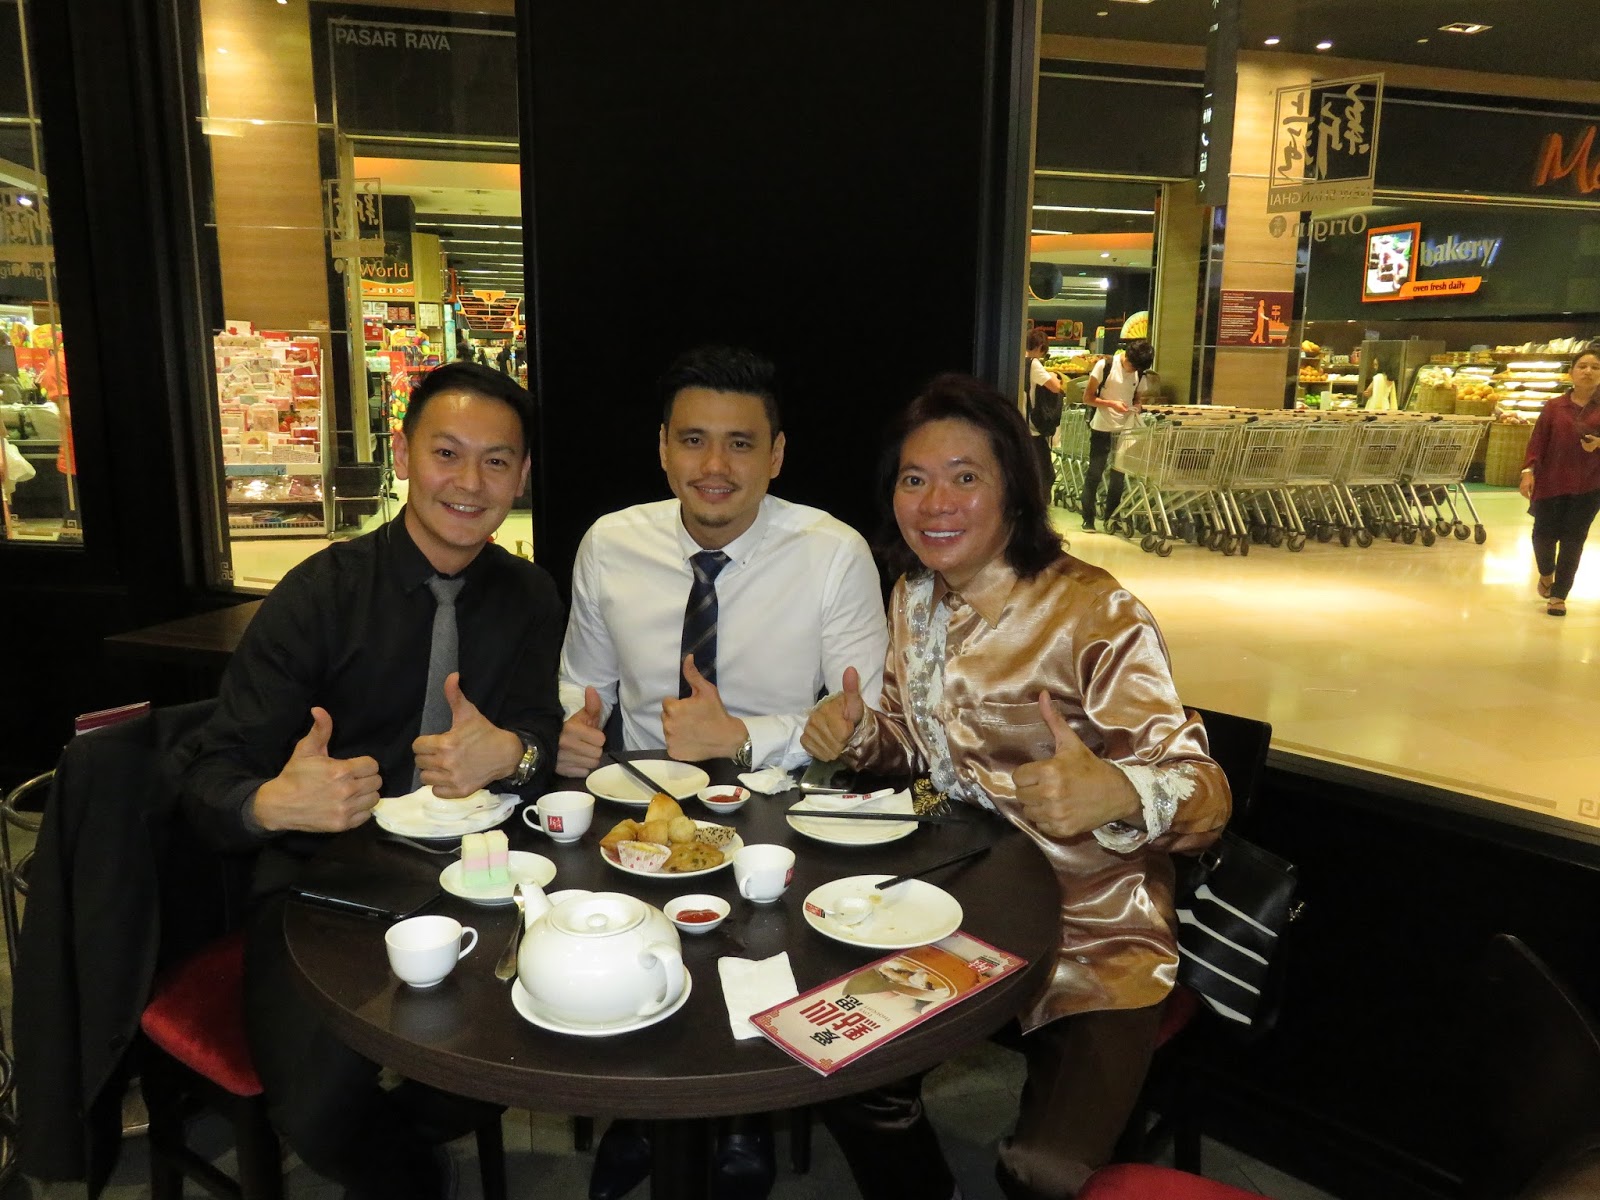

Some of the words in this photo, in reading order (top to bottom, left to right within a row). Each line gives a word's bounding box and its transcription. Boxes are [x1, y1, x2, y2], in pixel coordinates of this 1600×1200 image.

[335, 27, 397, 47] PASAR
[405, 32, 451, 51] RAYA
[1419, 235, 1498, 268] bakery
[360, 262, 409, 278] World
[1413, 283, 1429, 292] oven
[1430, 282, 1447, 291] fresh
[1448, 281, 1466, 291] daily
[486, 292, 492, 302] 3
